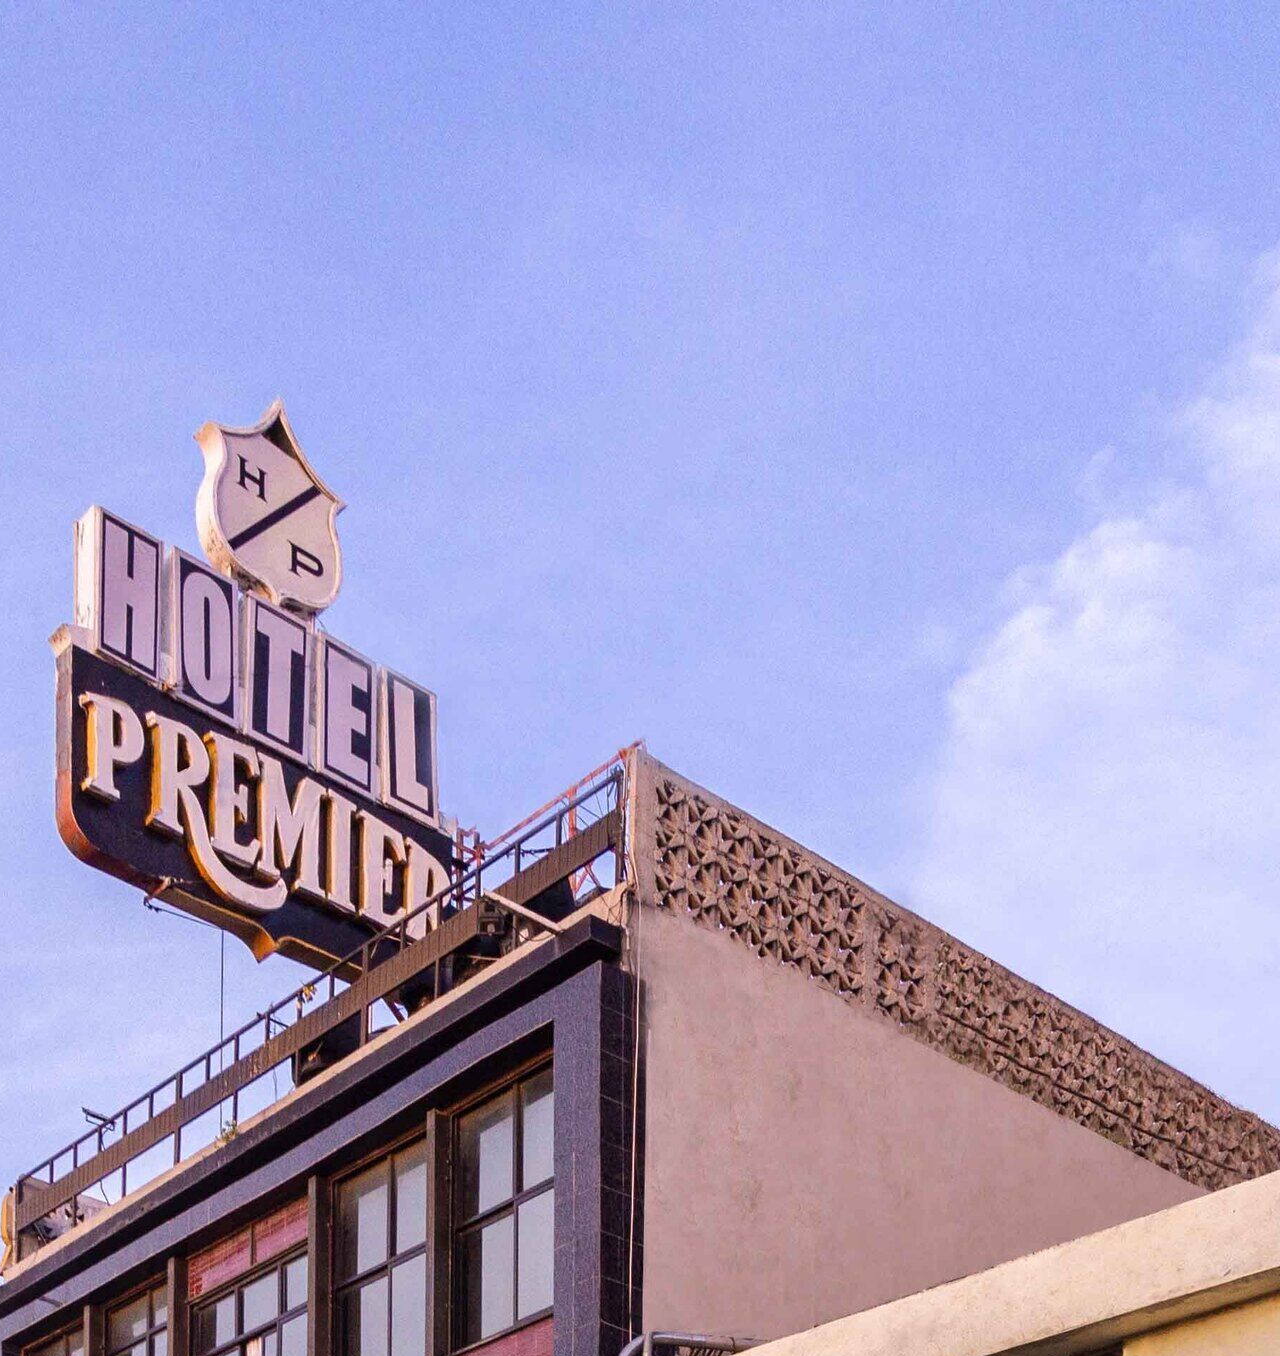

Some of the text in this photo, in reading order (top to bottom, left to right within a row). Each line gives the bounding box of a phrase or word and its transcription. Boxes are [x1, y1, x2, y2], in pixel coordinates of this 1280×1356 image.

[236, 454, 267, 502] H
[288, 540, 324, 577] P
[103, 514, 431, 813] HOTEL
[79, 693, 451, 941] PREMIER
